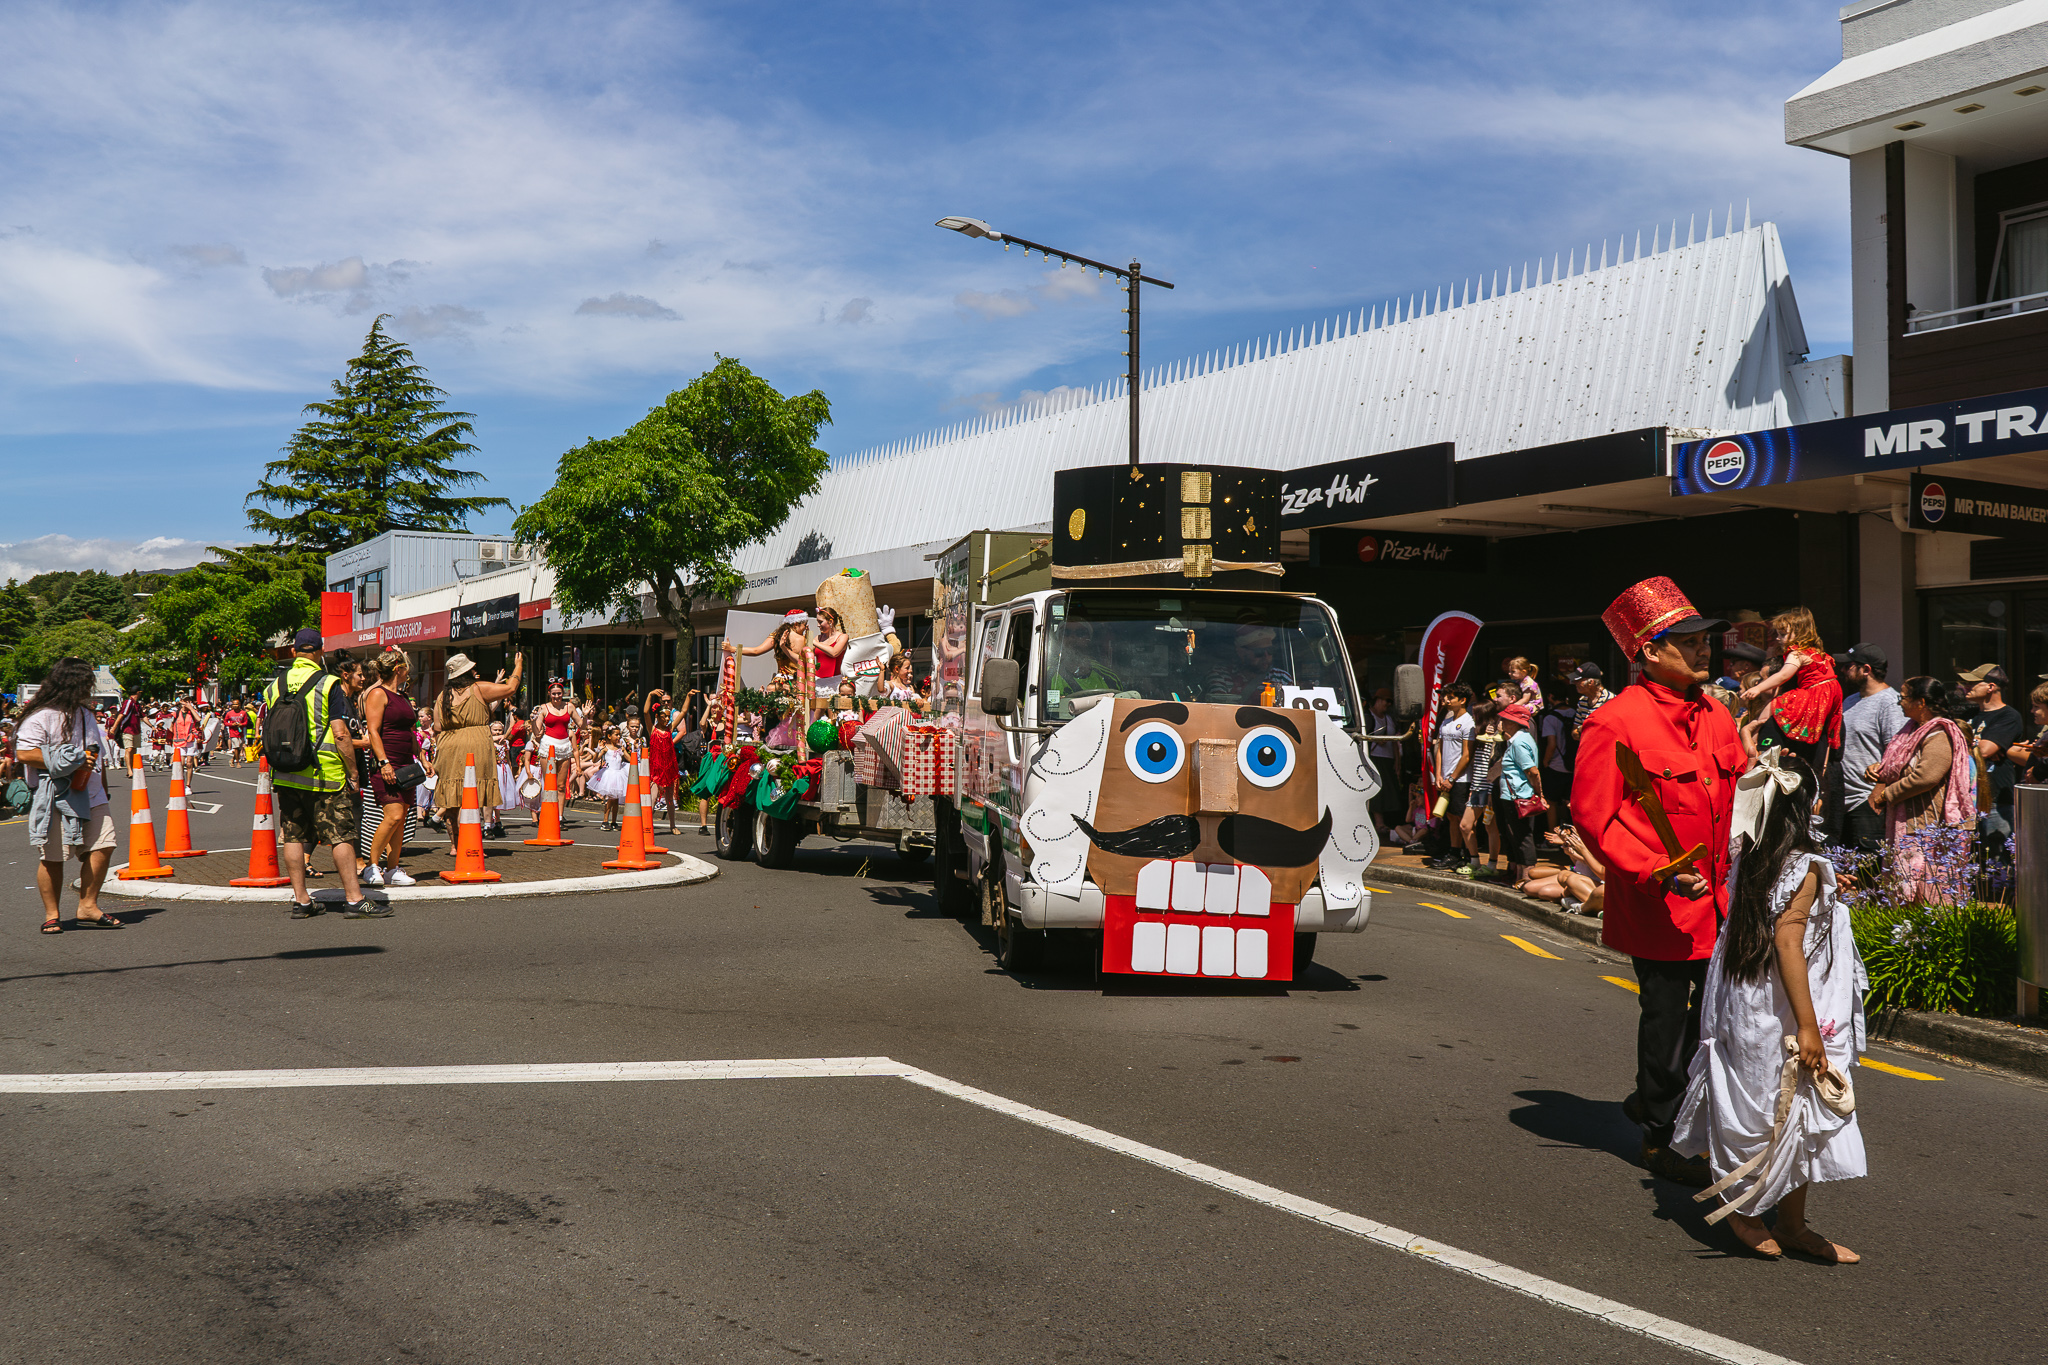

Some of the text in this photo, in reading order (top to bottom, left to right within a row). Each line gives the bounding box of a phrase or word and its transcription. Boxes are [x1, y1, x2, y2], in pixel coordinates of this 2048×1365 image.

[1865, 405, 2048, 457] MR TR
[1707, 456, 1742, 469] PEPSI
[1281, 473, 1379, 515] izza Hut
[1922, 497, 1945, 509] PEPSI
[1954, 498, 2048, 523] MR TRAN BAKER
[1380, 539, 1452, 561] Pizza Hut
[743, 576, 778, 590] EVELOPMENT
[385, 626, 394, 640] RED
[394, 623, 408, 639] CROSS
[408, 621, 422, 637] SHOP
[1724, 634, 1738, 646] THE
[1433, 640, 1446, 685] Hut
